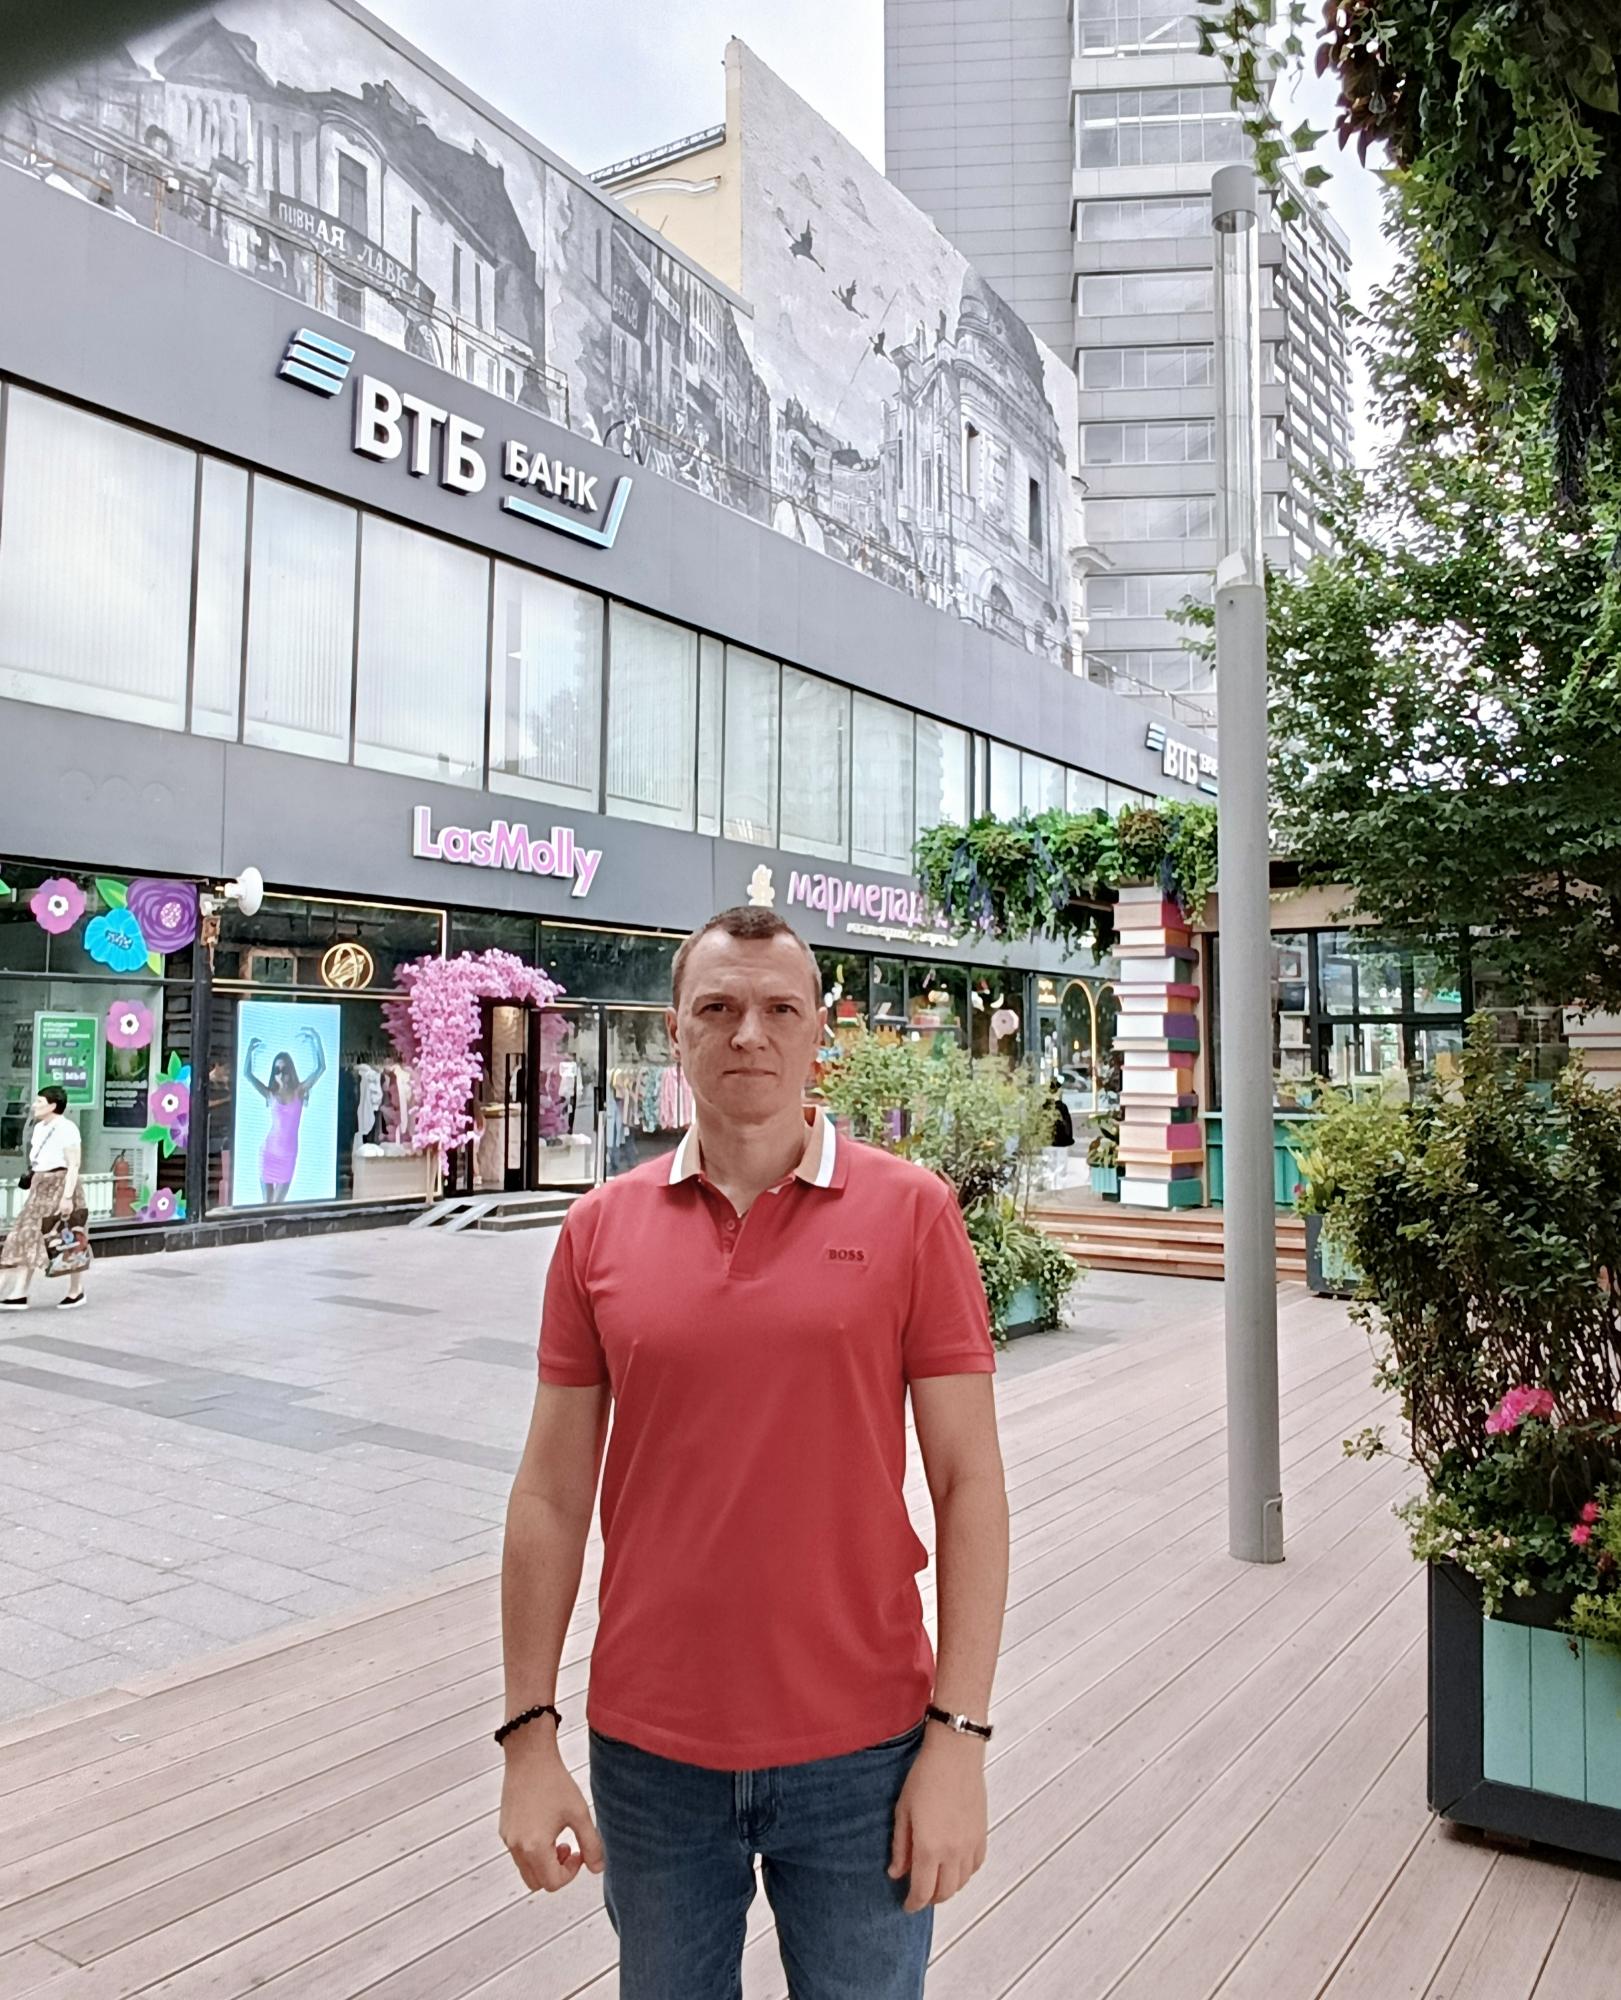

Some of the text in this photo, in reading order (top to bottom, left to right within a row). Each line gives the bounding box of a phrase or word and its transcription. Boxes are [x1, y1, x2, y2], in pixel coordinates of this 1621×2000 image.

[357, 244, 421, 298] ЛАВКА
[354, 373, 598, 512] ВТБ БАНК
[1163, 737, 1199, 785] ВТБ
[413, 805, 603, 898] LasMolly
[828, 1249, 865, 1261] BOSS
